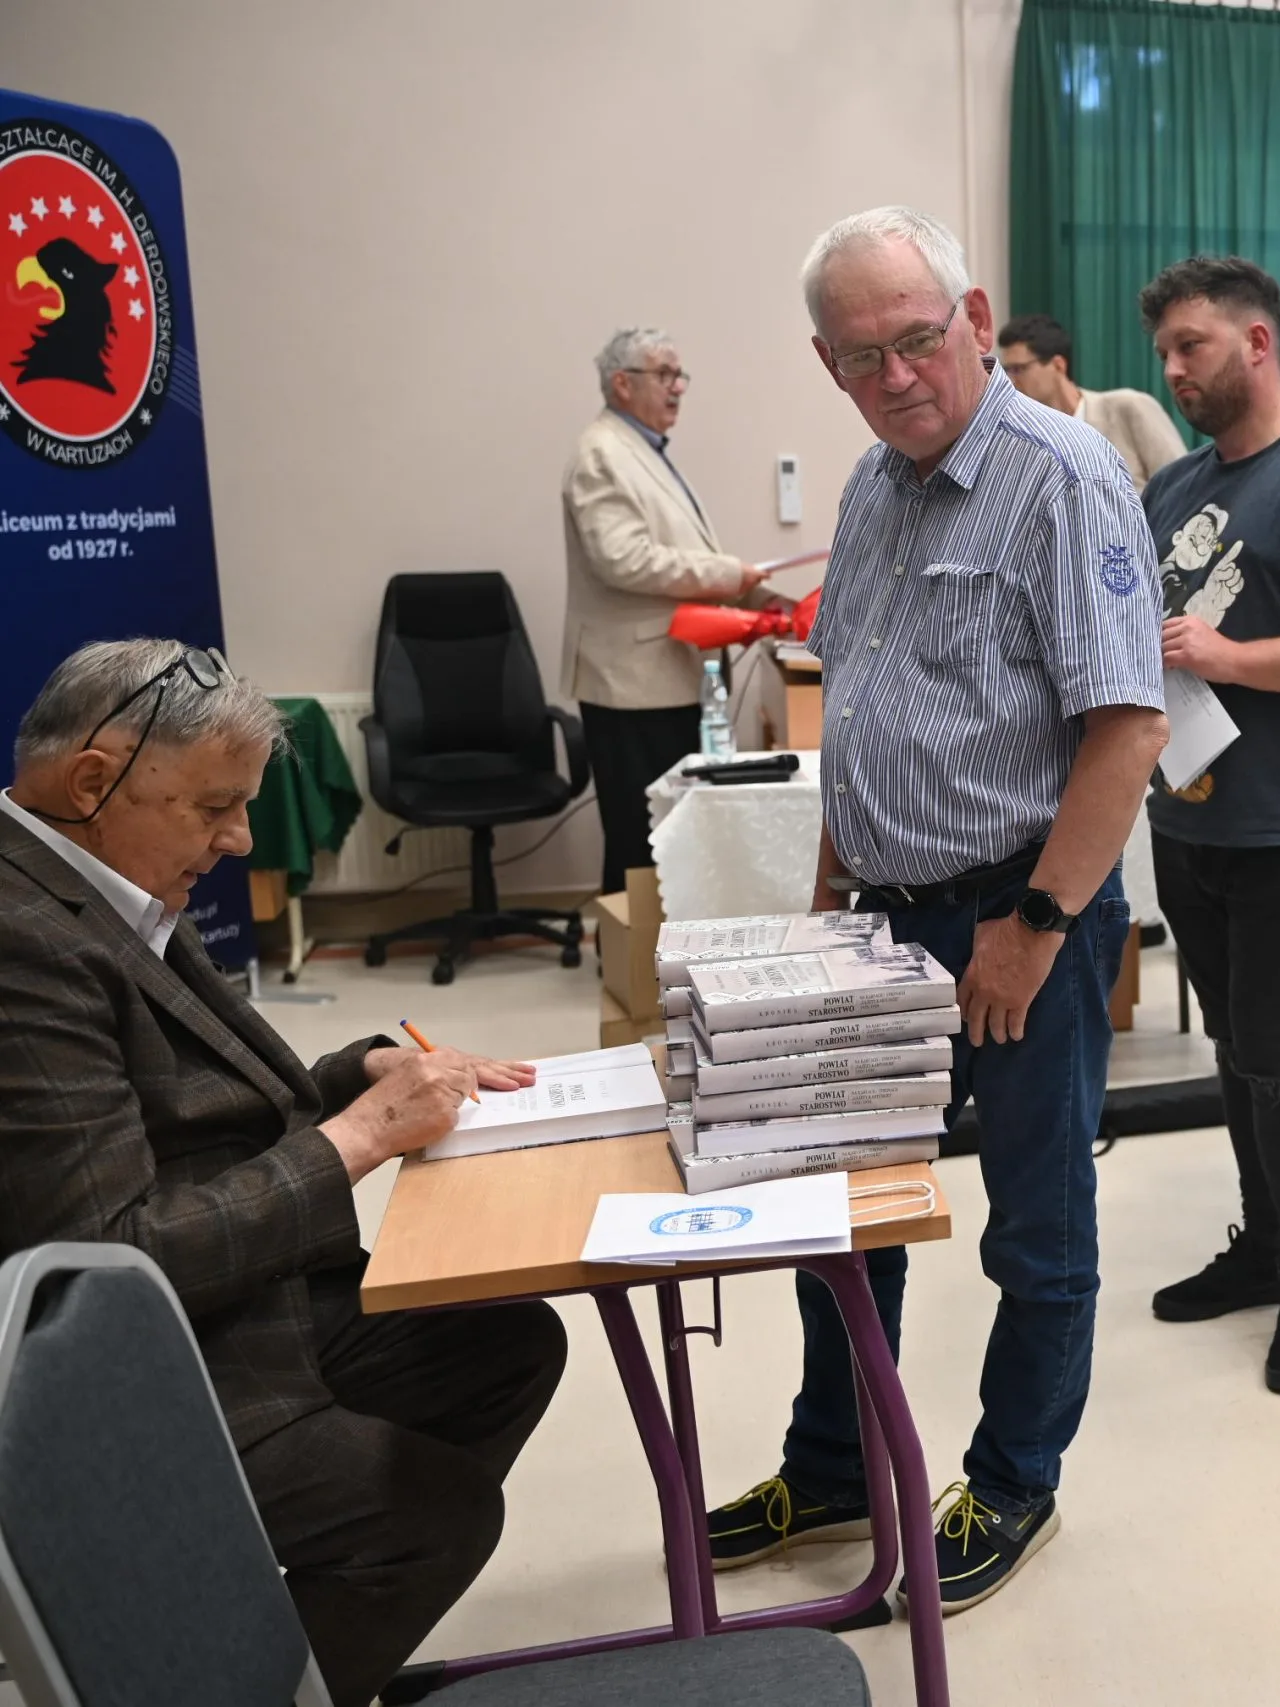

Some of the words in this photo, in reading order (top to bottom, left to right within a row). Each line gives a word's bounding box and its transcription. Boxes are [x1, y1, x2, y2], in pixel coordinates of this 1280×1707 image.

[96, 158, 117, 190] IM.
[119, 187, 134, 212] H.
[133, 213, 172, 395] DERDOWSKIEGO
[26, 429, 45, 451] W
[45, 429, 133, 464] KARTUZACH
[66, 514, 78, 531] z
[80, 505, 176, 532] tradycjami
[48, 540, 73, 560] od
[76, 538, 117, 559] 1927
[120, 541, 134, 557] r.
[823, 996, 854, 1006] POWIAT
[808, 1006, 855, 1017] STAROSTWO
[830, 1024, 860, 1035] POWIAT
[815, 1035, 861, 1046] STAROSTWO
[818, 1060, 849, 1069] POWIAT
[803, 1070, 849, 1081] STAROSTWO
[815, 1090, 845, 1100] POWIAT
[800, 1100, 846, 1111] STAROSTWO
[806, 1152, 836, 1163] POWIAT
[790, 1162, 837, 1175] STAROSTWO
